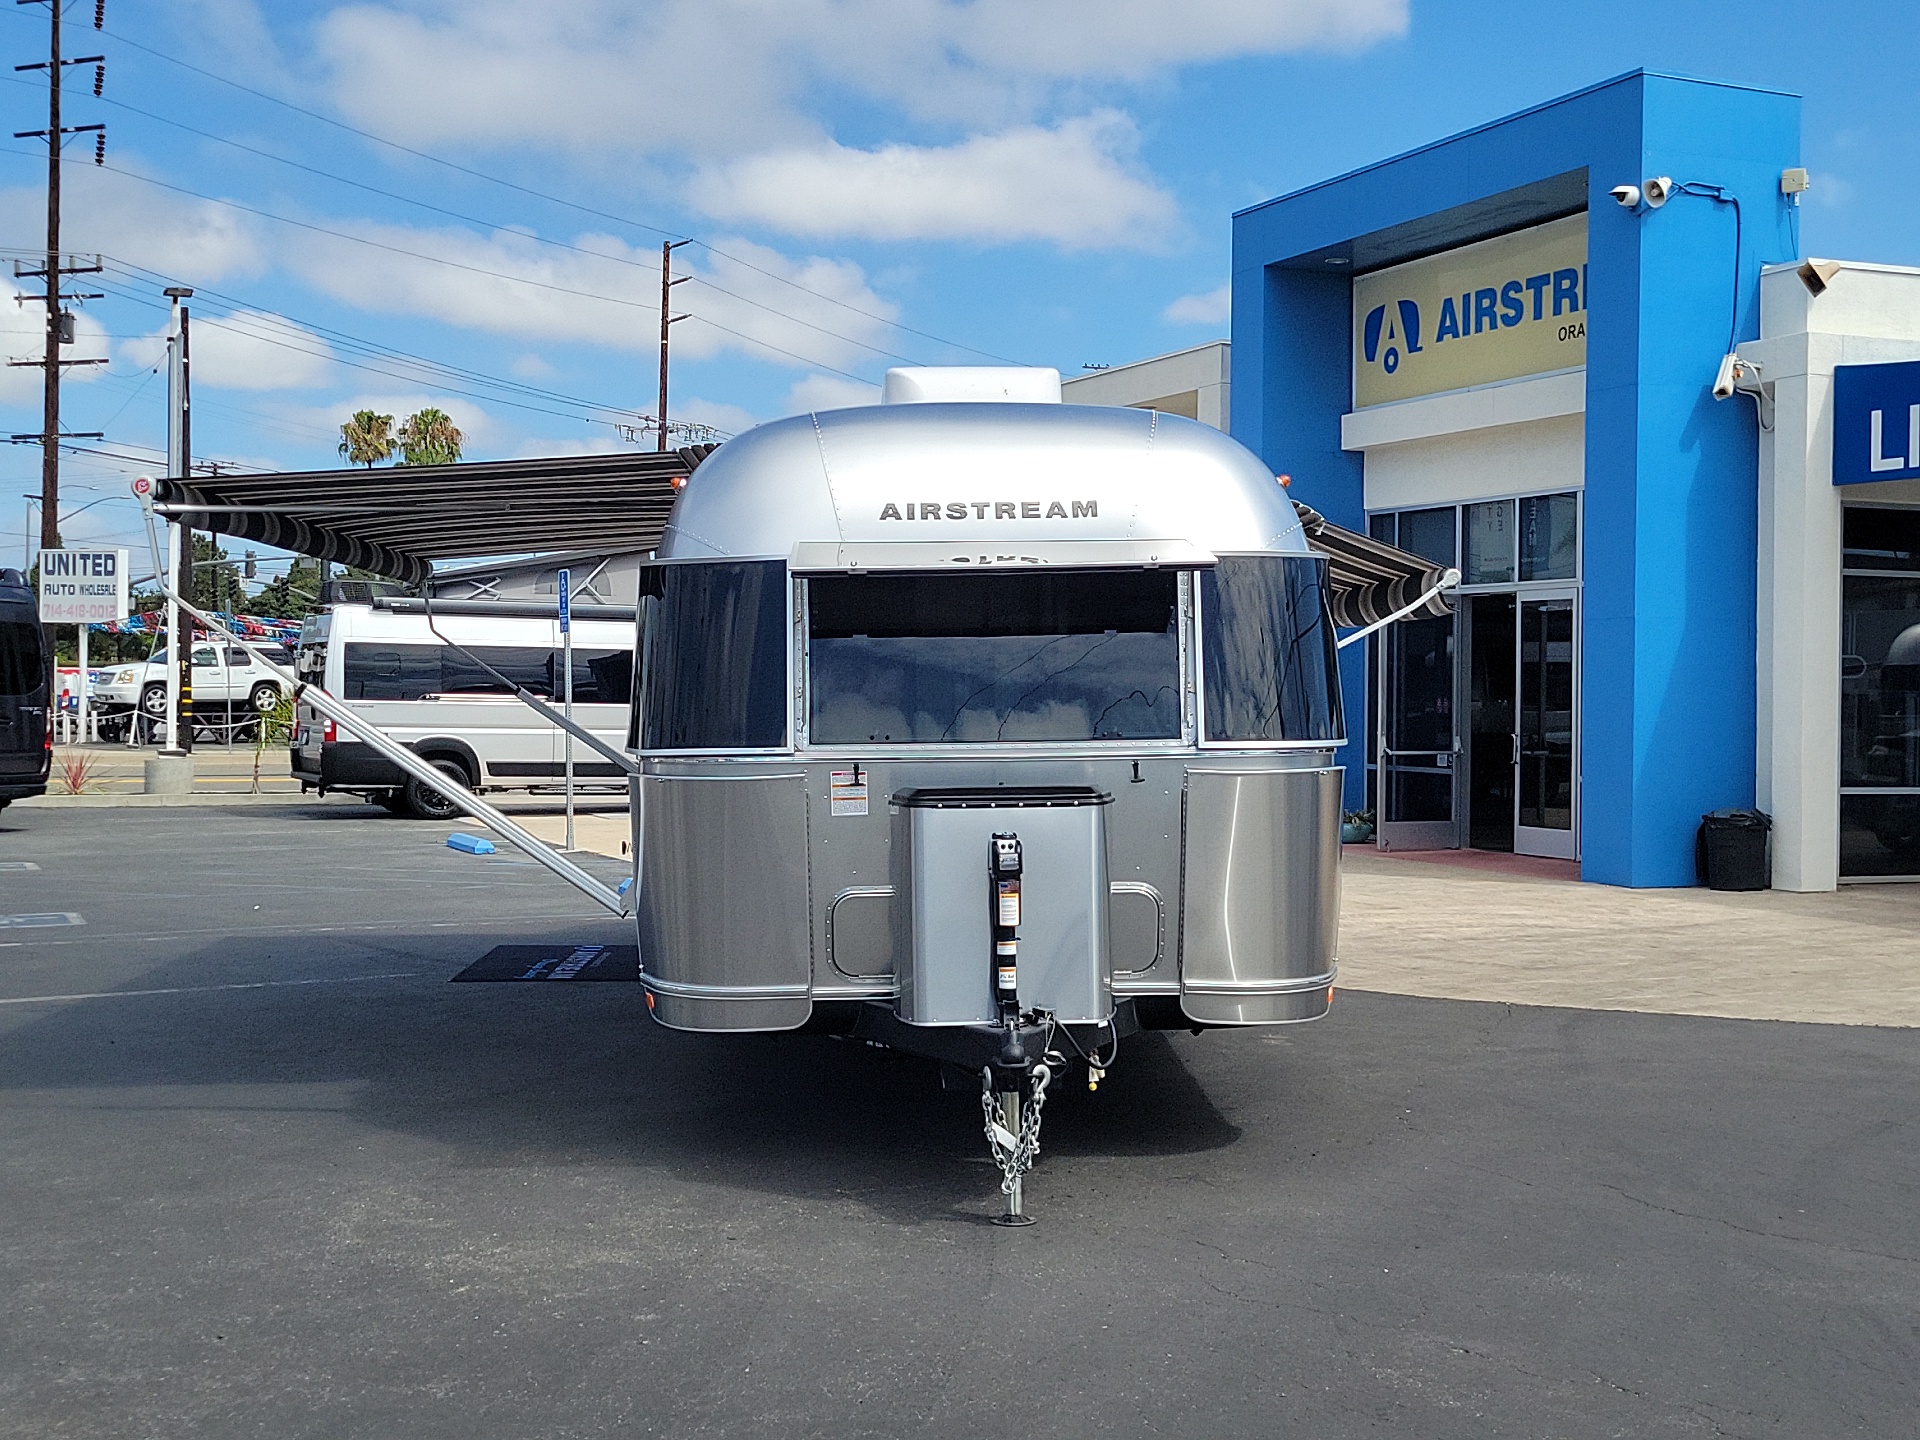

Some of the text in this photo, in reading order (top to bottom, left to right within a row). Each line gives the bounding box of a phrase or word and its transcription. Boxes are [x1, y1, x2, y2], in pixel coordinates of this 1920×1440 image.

[1558, 322, 1586, 341] ORA
[879, 500, 1098, 520] AIRSTREAM
[44, 553, 116, 576] UNITED
[44, 583, 117, 596] AUTO WHOLESALE
[43, 603, 117, 618] 714-418-0012
